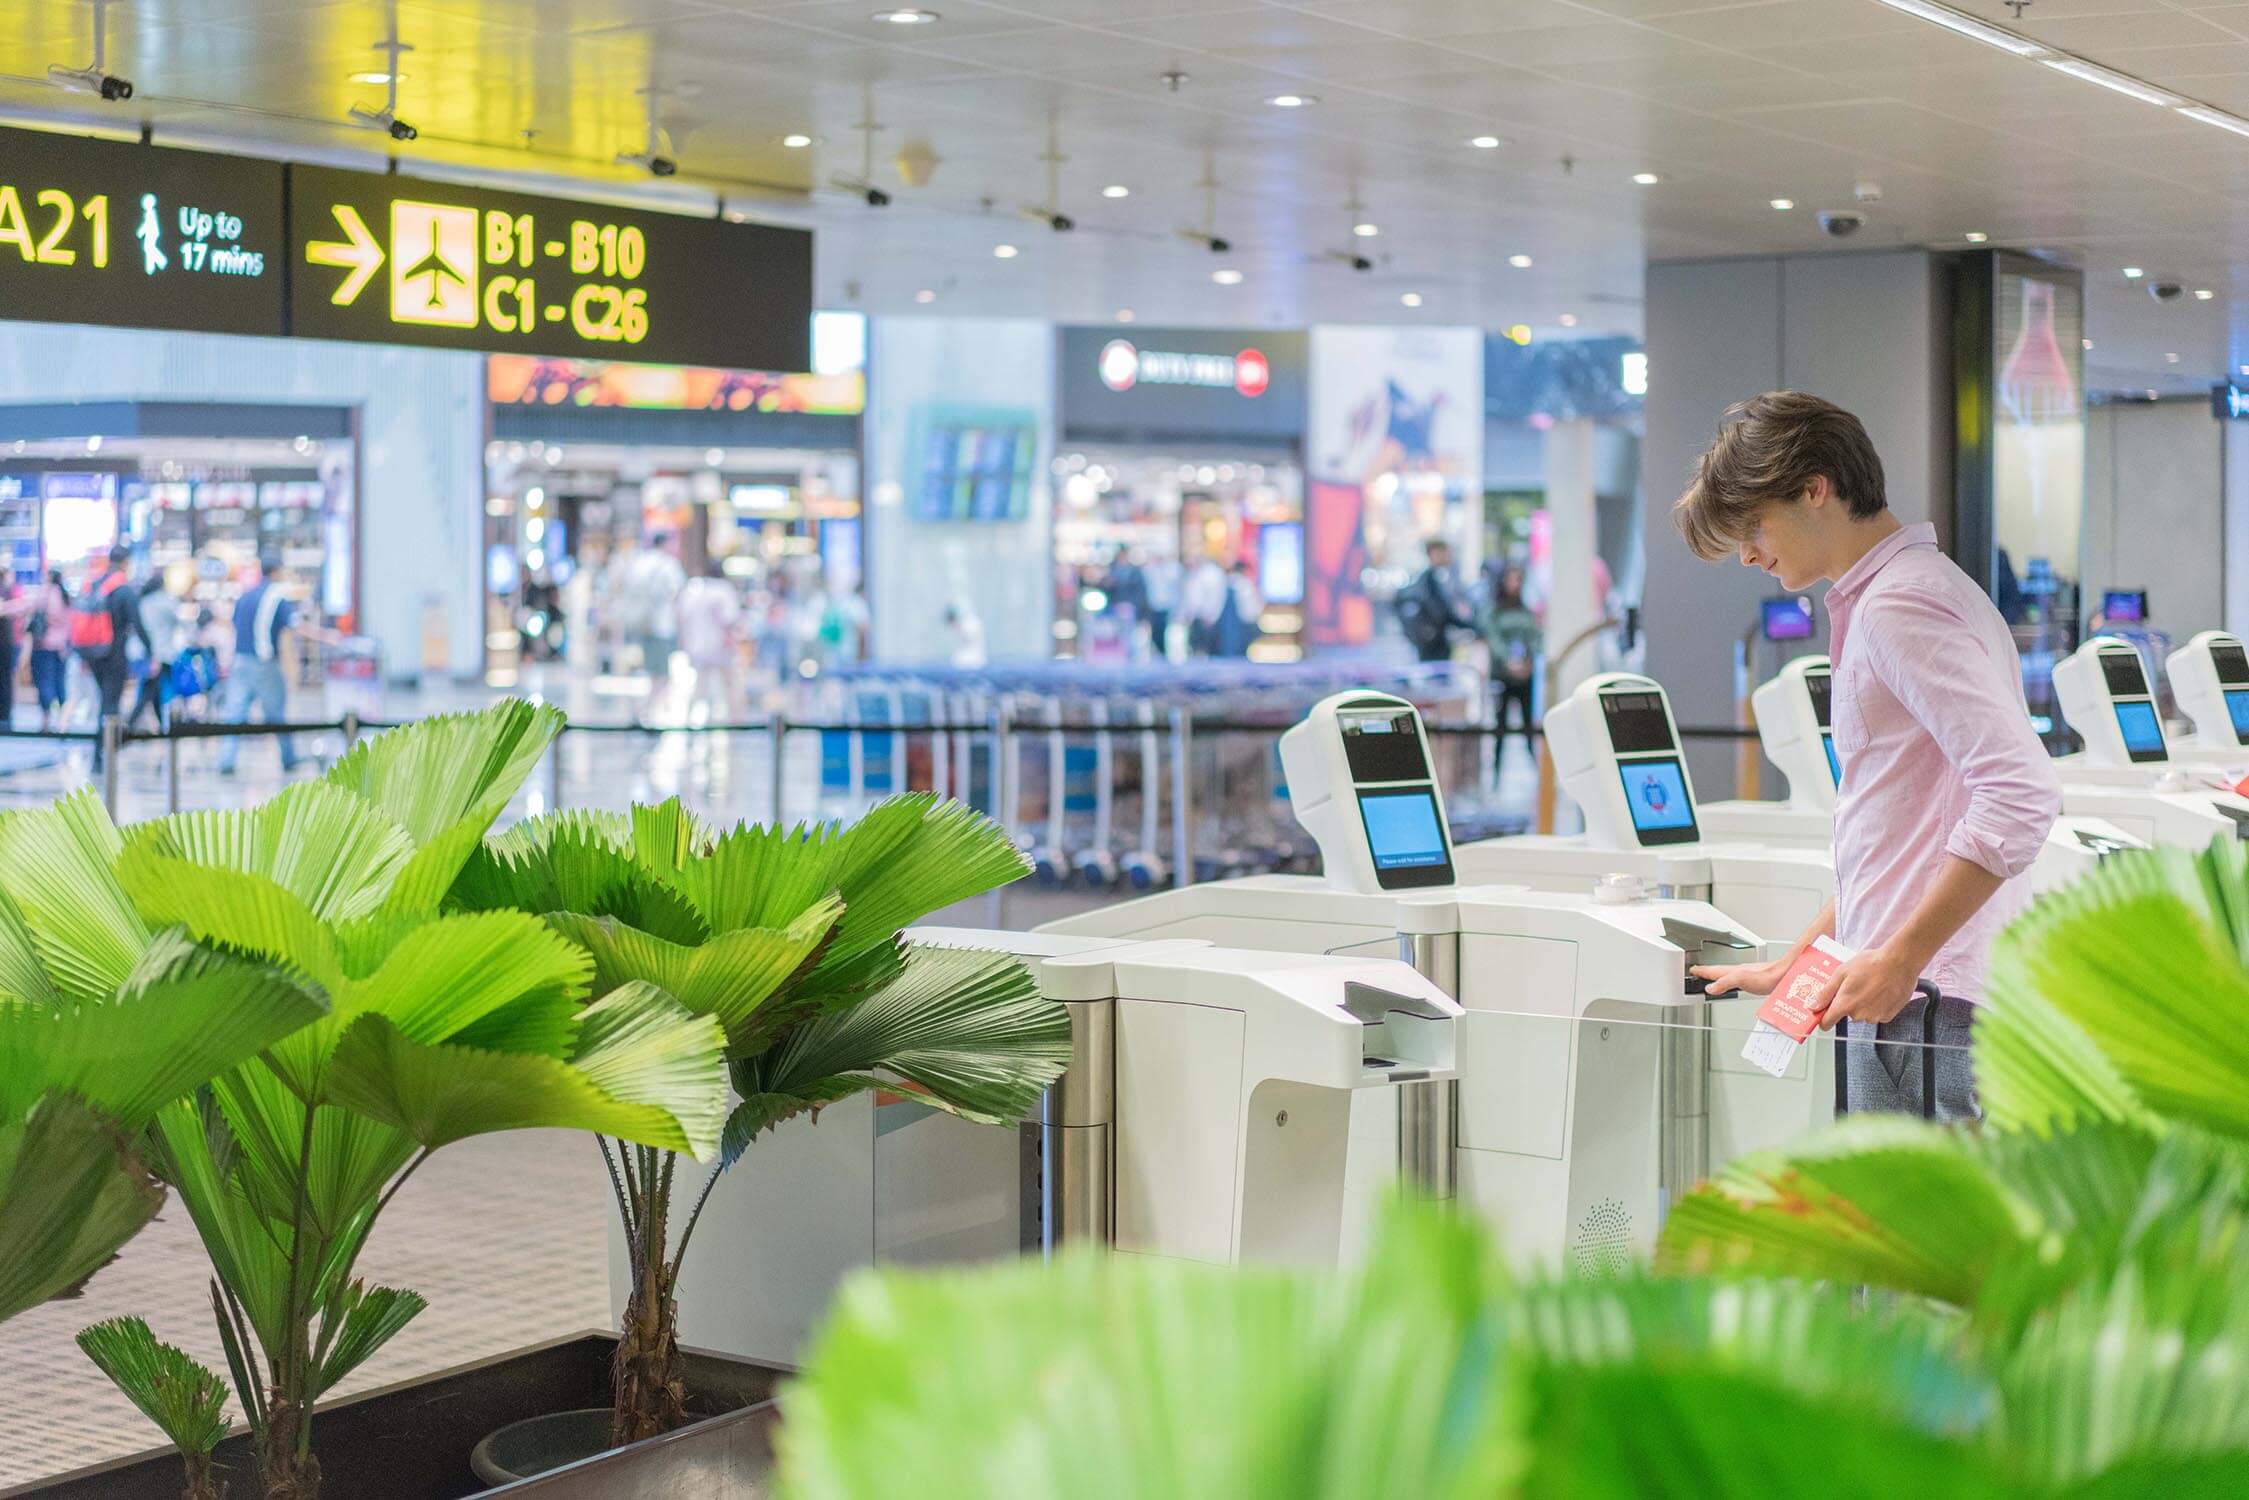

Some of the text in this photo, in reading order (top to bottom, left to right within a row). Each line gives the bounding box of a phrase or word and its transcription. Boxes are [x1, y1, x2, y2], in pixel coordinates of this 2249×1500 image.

[0, 186, 109, 268] A21
[179, 207, 242, 241] Up to
[485, 210, 534, 267] B1
[571, 220, 645, 279] B10
[180, 242, 264, 276] 17 mins
[483, 275, 535, 333] C1
[570, 284, 648, 343] C26
